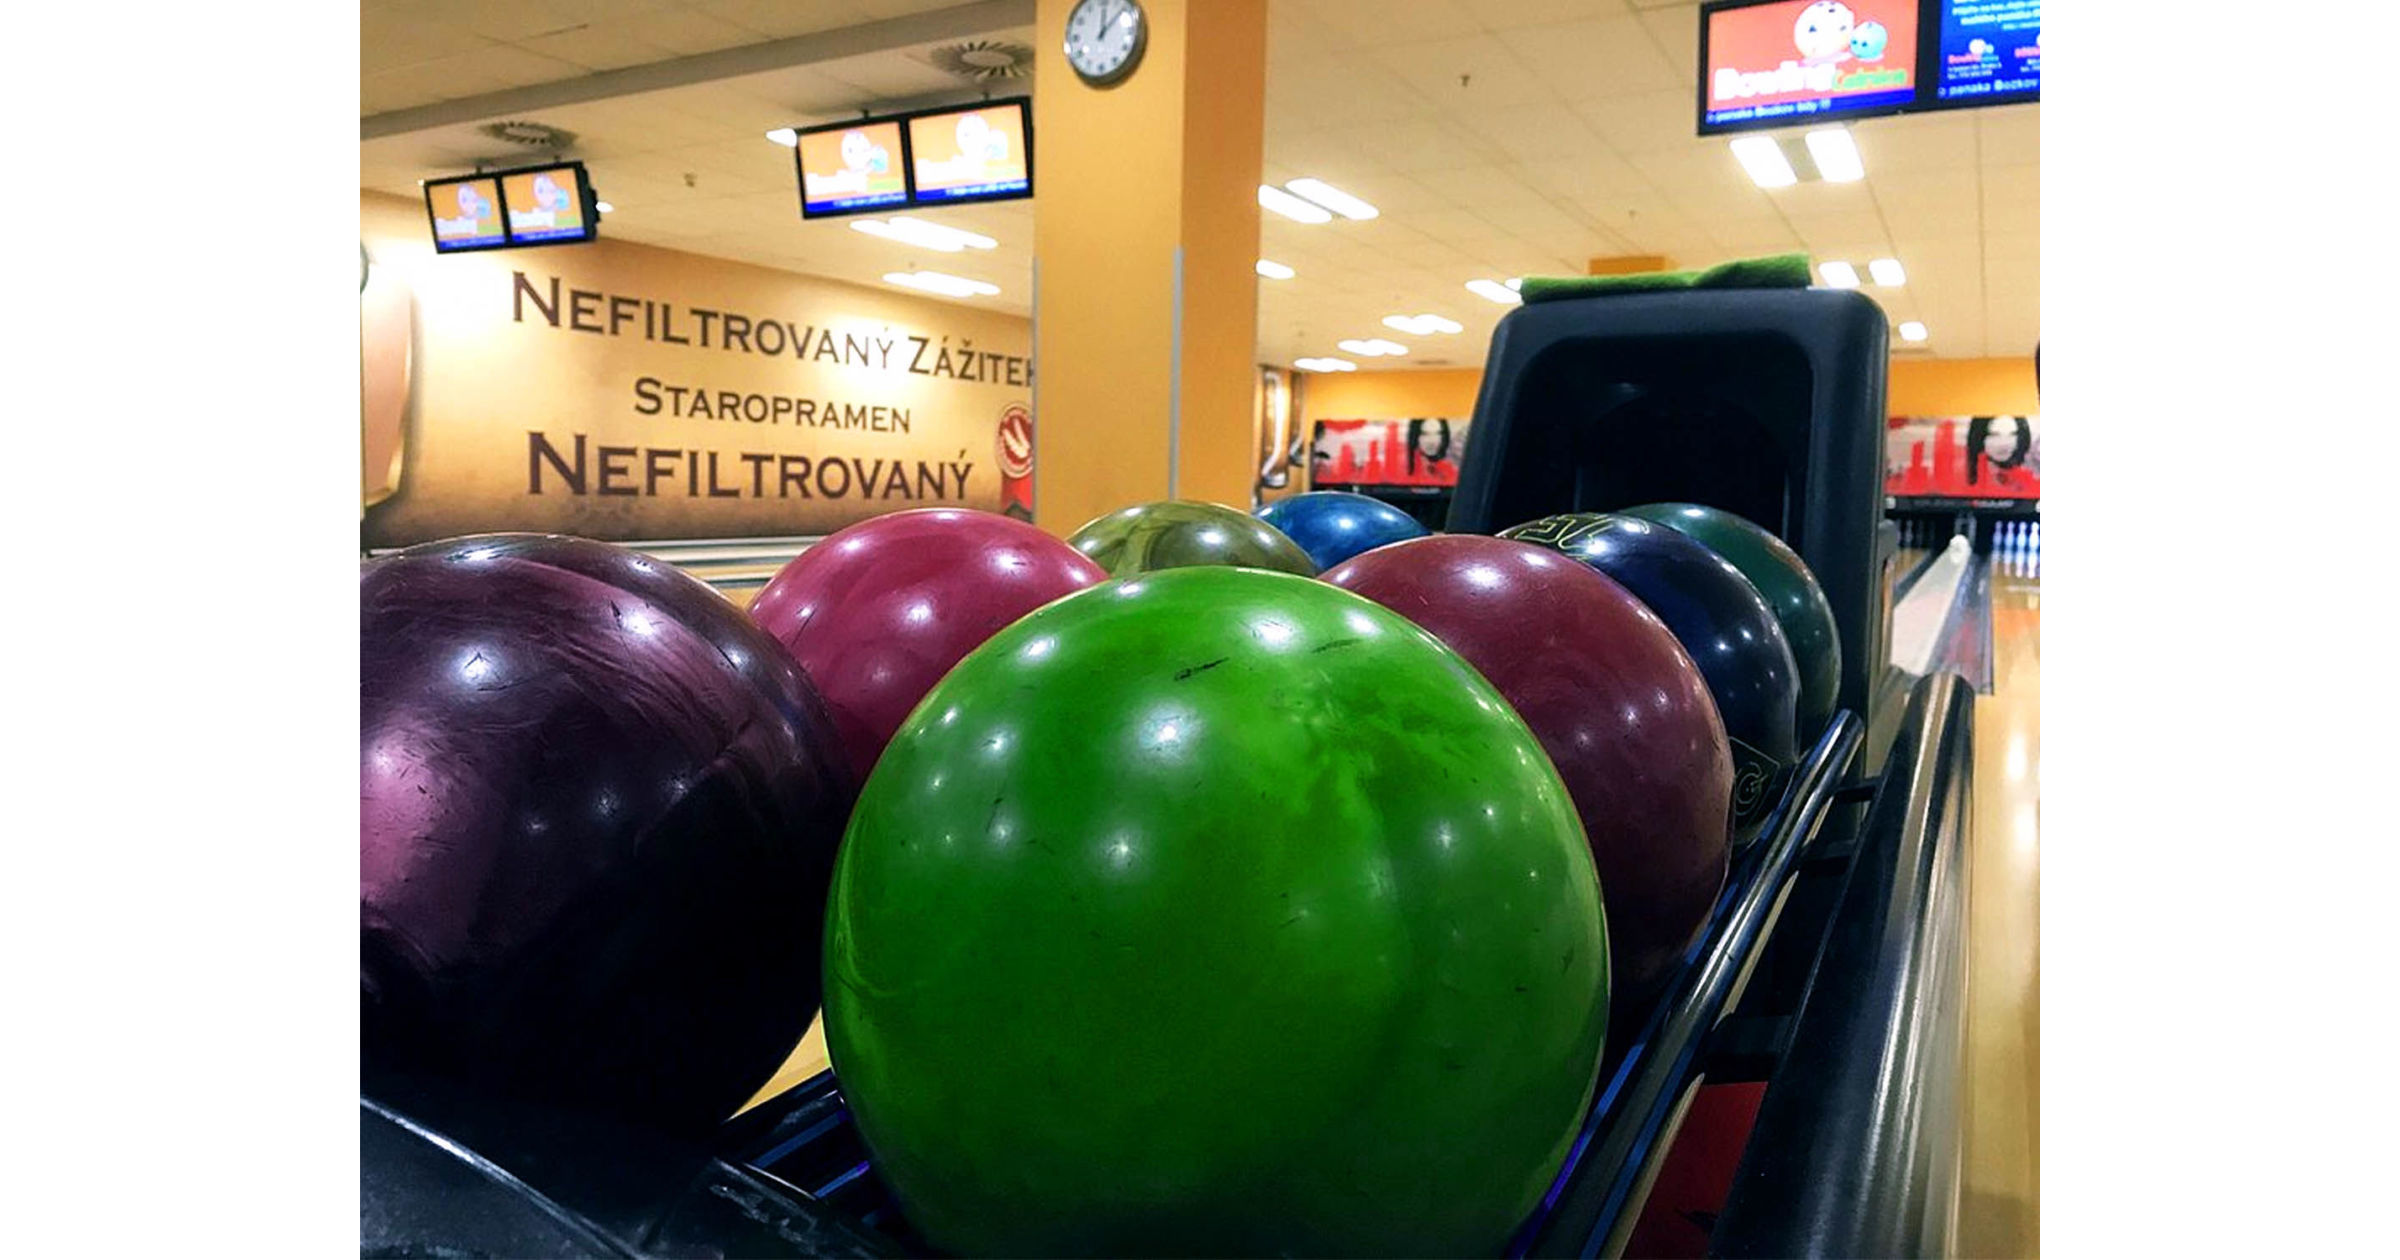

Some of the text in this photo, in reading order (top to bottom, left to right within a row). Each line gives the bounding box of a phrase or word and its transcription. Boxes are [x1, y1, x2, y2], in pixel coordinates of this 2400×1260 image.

[513, 271, 894, 369] NEFILTROVANÝ
[634, 377, 911, 434] STAROPRAMEN
[528, 430, 974, 500] NEFILTROVANÝ
